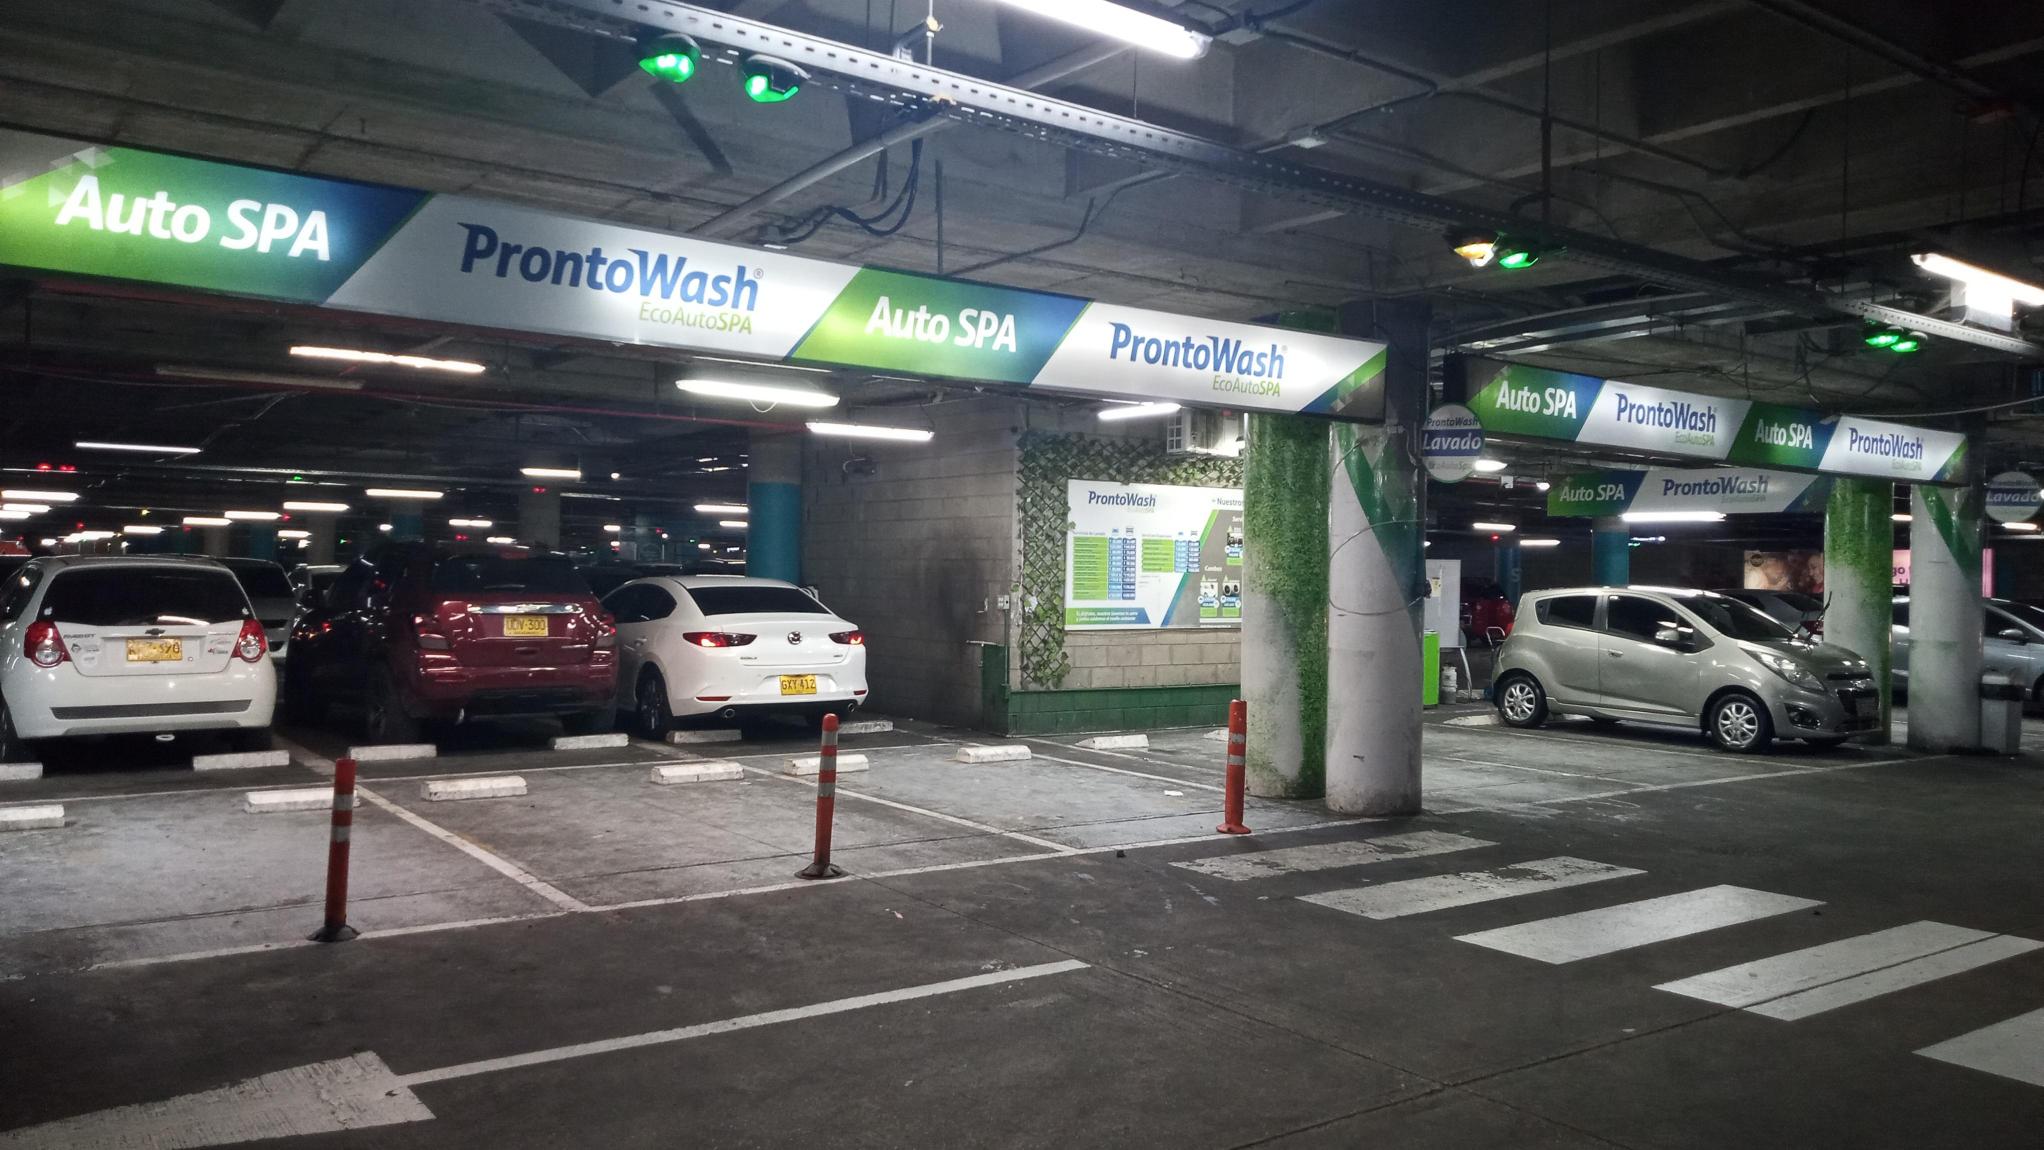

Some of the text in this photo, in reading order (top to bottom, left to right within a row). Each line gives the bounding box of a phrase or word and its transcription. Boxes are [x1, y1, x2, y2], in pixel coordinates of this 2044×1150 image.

[55, 174, 331, 261] Auto SPA
[638, 302, 753, 334] EcoAutoSPA
[864, 295, 1017, 353] Auto SPA
[1108, 321, 1286, 380] ProntoWash
[1212, 375, 1281, 397] EcoAutoSPA
[1495, 380, 1577, 419] Auto SPA
[1615, 392, 1717, 433] ProntoWash
[1423, 432, 1482, 451] Lavado
[1754, 418, 1813, 450] Auto SPA
[1848, 427, 1923, 460] ProntoWash
[1088, 490, 1156, 508] ProntoWash
[1559, 483, 1625, 502] Auto SPA
[1662, 475, 1769, 497] ProntoWash
[1985, 490, 2040, 503] Lavado
